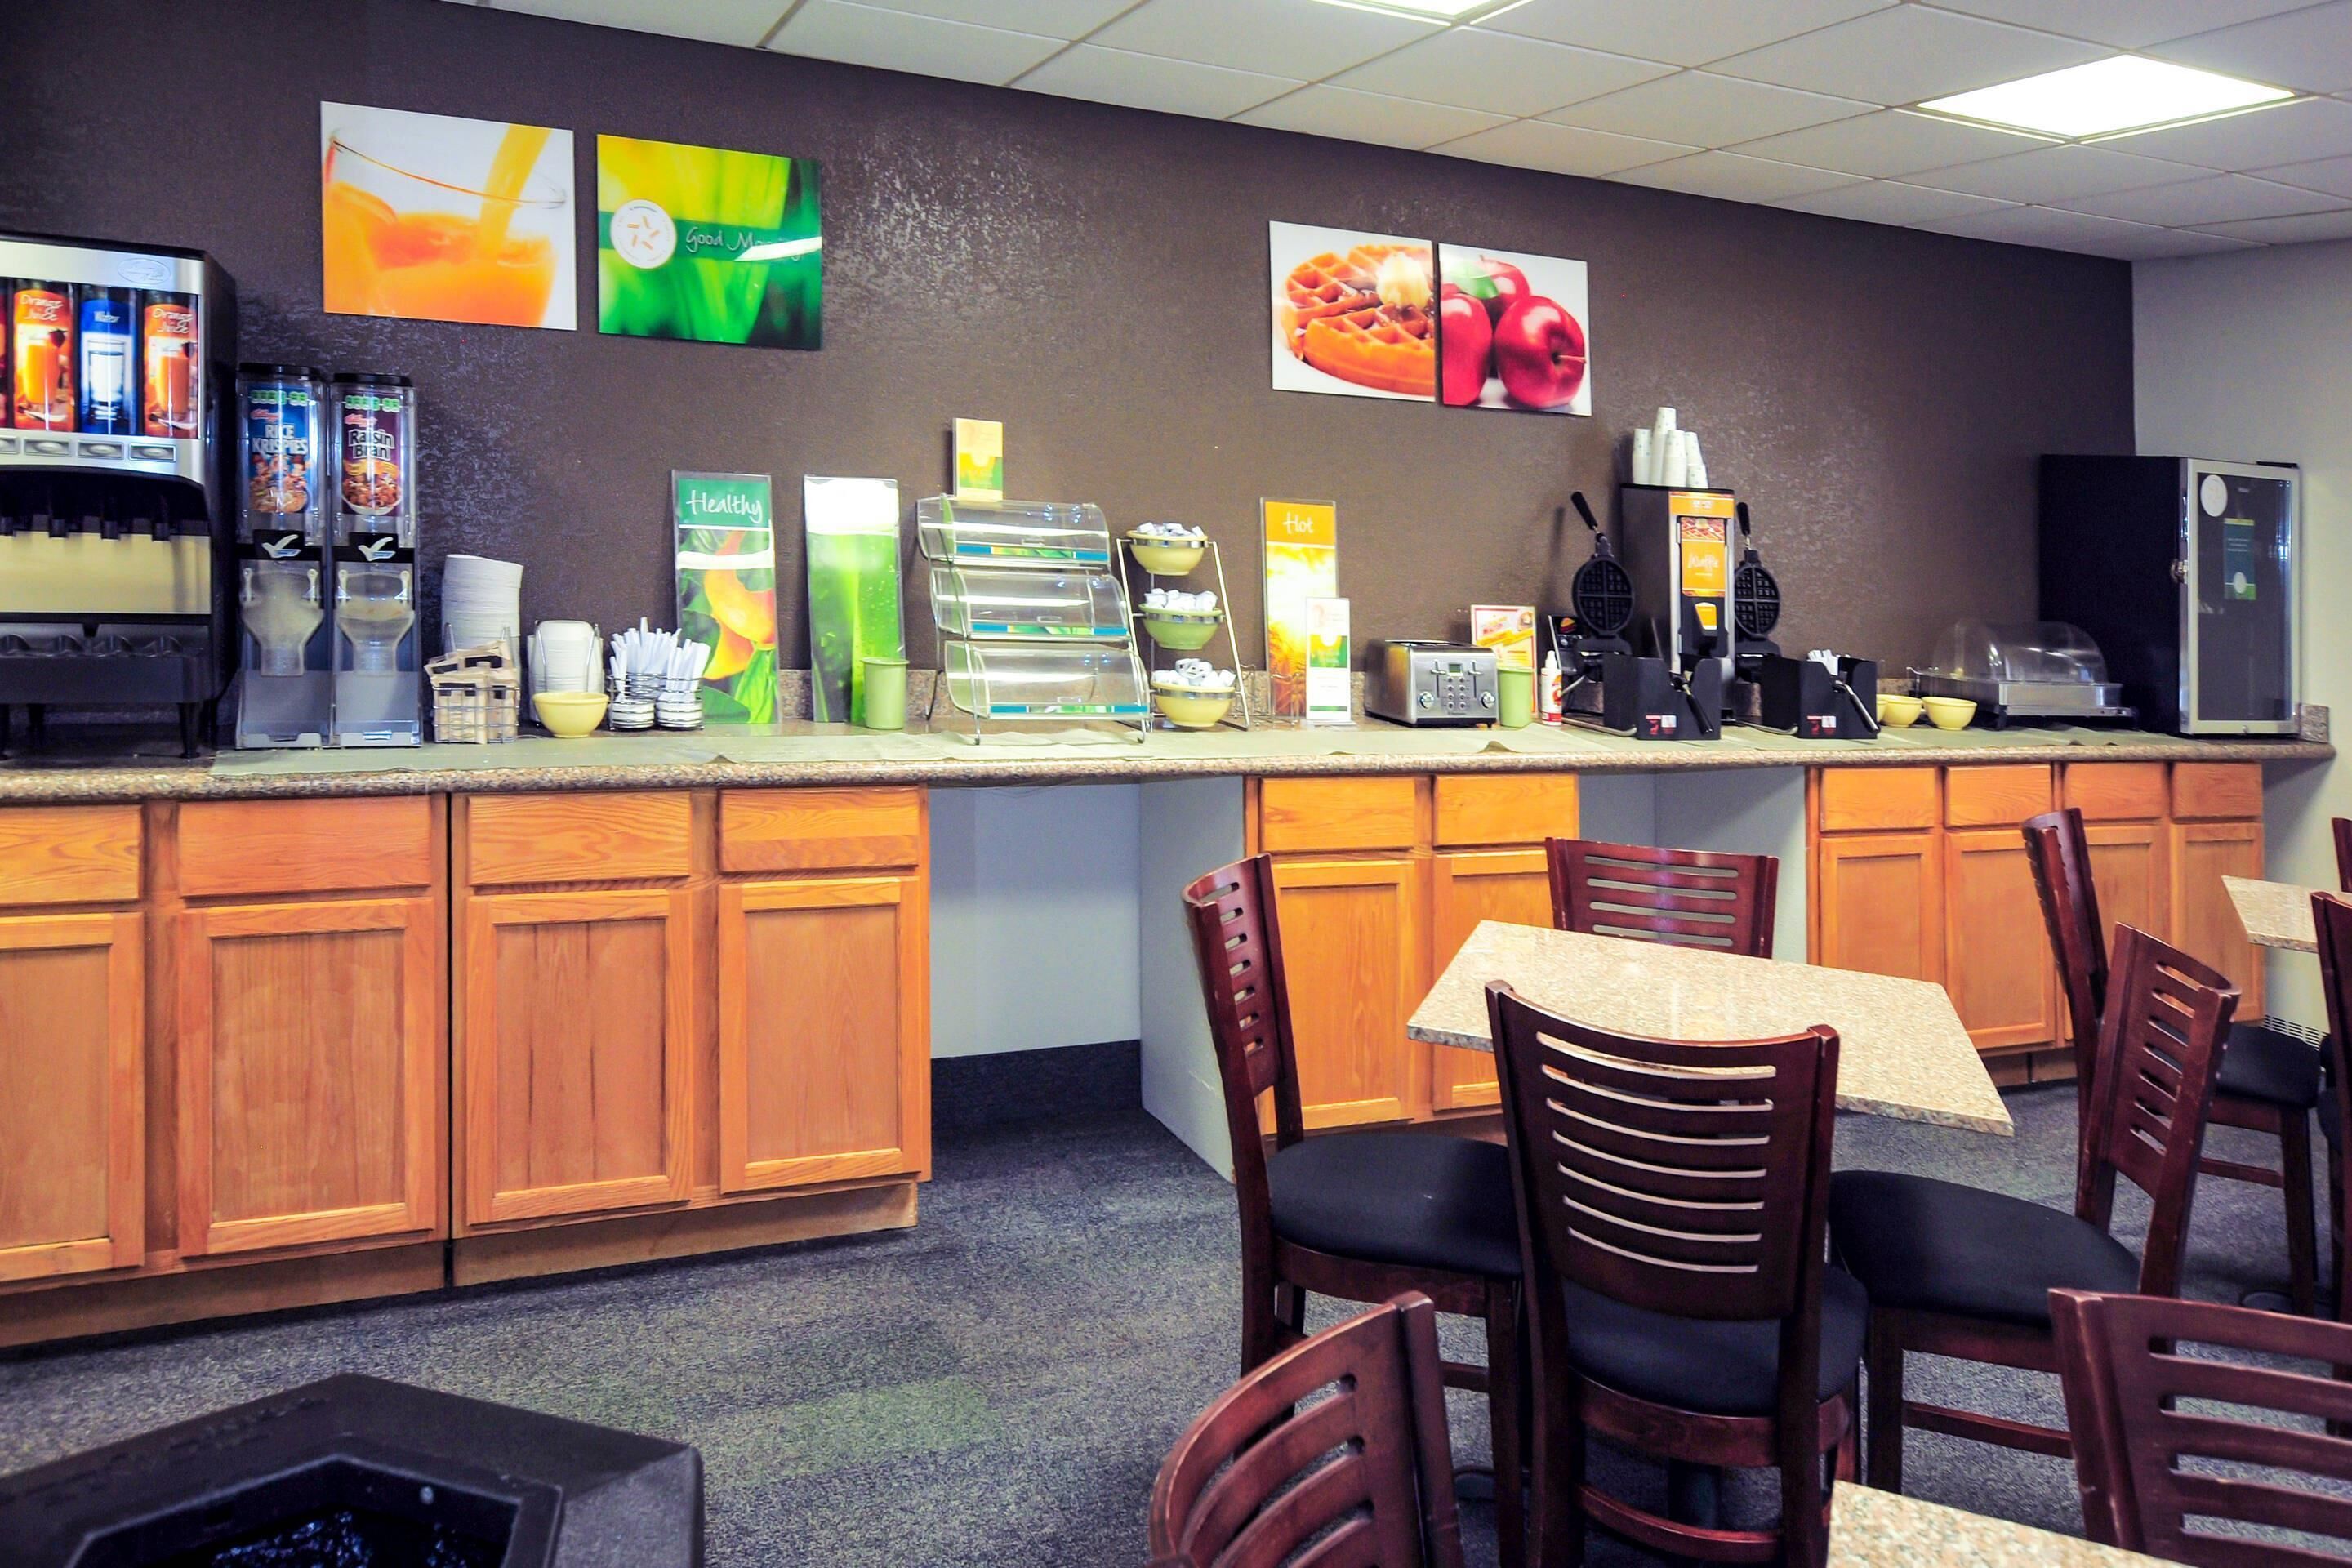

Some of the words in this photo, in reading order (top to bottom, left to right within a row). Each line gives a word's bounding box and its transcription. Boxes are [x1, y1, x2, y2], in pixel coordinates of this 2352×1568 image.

[685, 226, 724, 253] Good
[20, 294, 64, 314] Orange
[24, 307, 60, 322] Juice
[152, 307, 194, 327] Orange
[156, 320, 189, 334] Juice
[265, 424, 295, 439] RICE
[353, 444, 391, 461] Bran
[686, 489, 763, 523] Healthy
[1282, 510, 1314, 535] Hot
